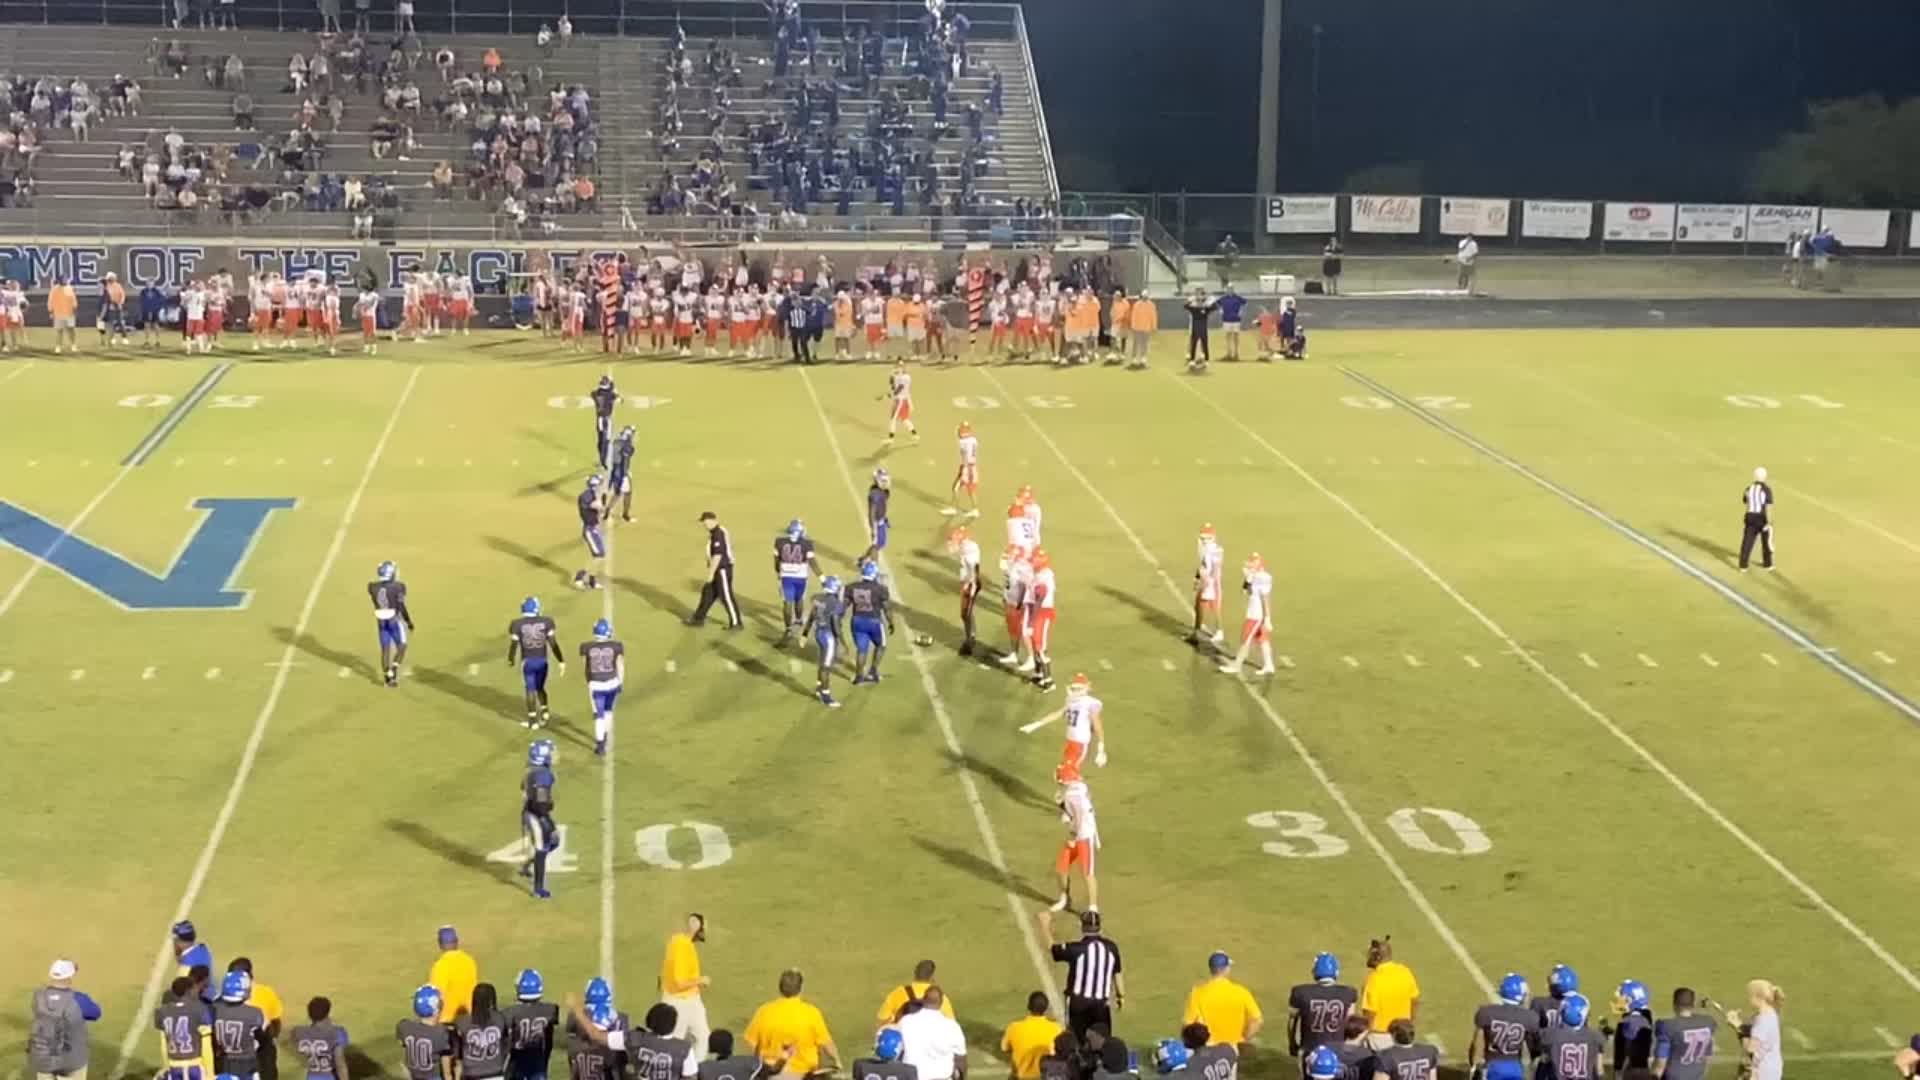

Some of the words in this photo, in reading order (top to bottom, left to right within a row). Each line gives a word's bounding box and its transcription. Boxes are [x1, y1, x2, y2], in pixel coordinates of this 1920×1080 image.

[1270, 199, 1285, 218] B
[127, 247, 205, 288] OF
[238, 248, 361, 290] THE
[484, 822, 733, 872] 40
[1246, 808, 1491, 858] 30
[1310, 999, 1345, 1033] 73
[163, 1016, 192, 1054] 14
[215, 1020, 244, 1053] 17
[466, 1026, 501, 1061] 28
[1491, 1019, 1525, 1055] 72
[1681, 1027, 1711, 1066] 77
[297, 1039, 333, 1072] 26
[404, 1035, 433, 1072] 10
[638, 1047, 672, 1080] 78
[1397, 1058, 1430, 1080] 75
[1559, 1042, 1589, 1080] 61
